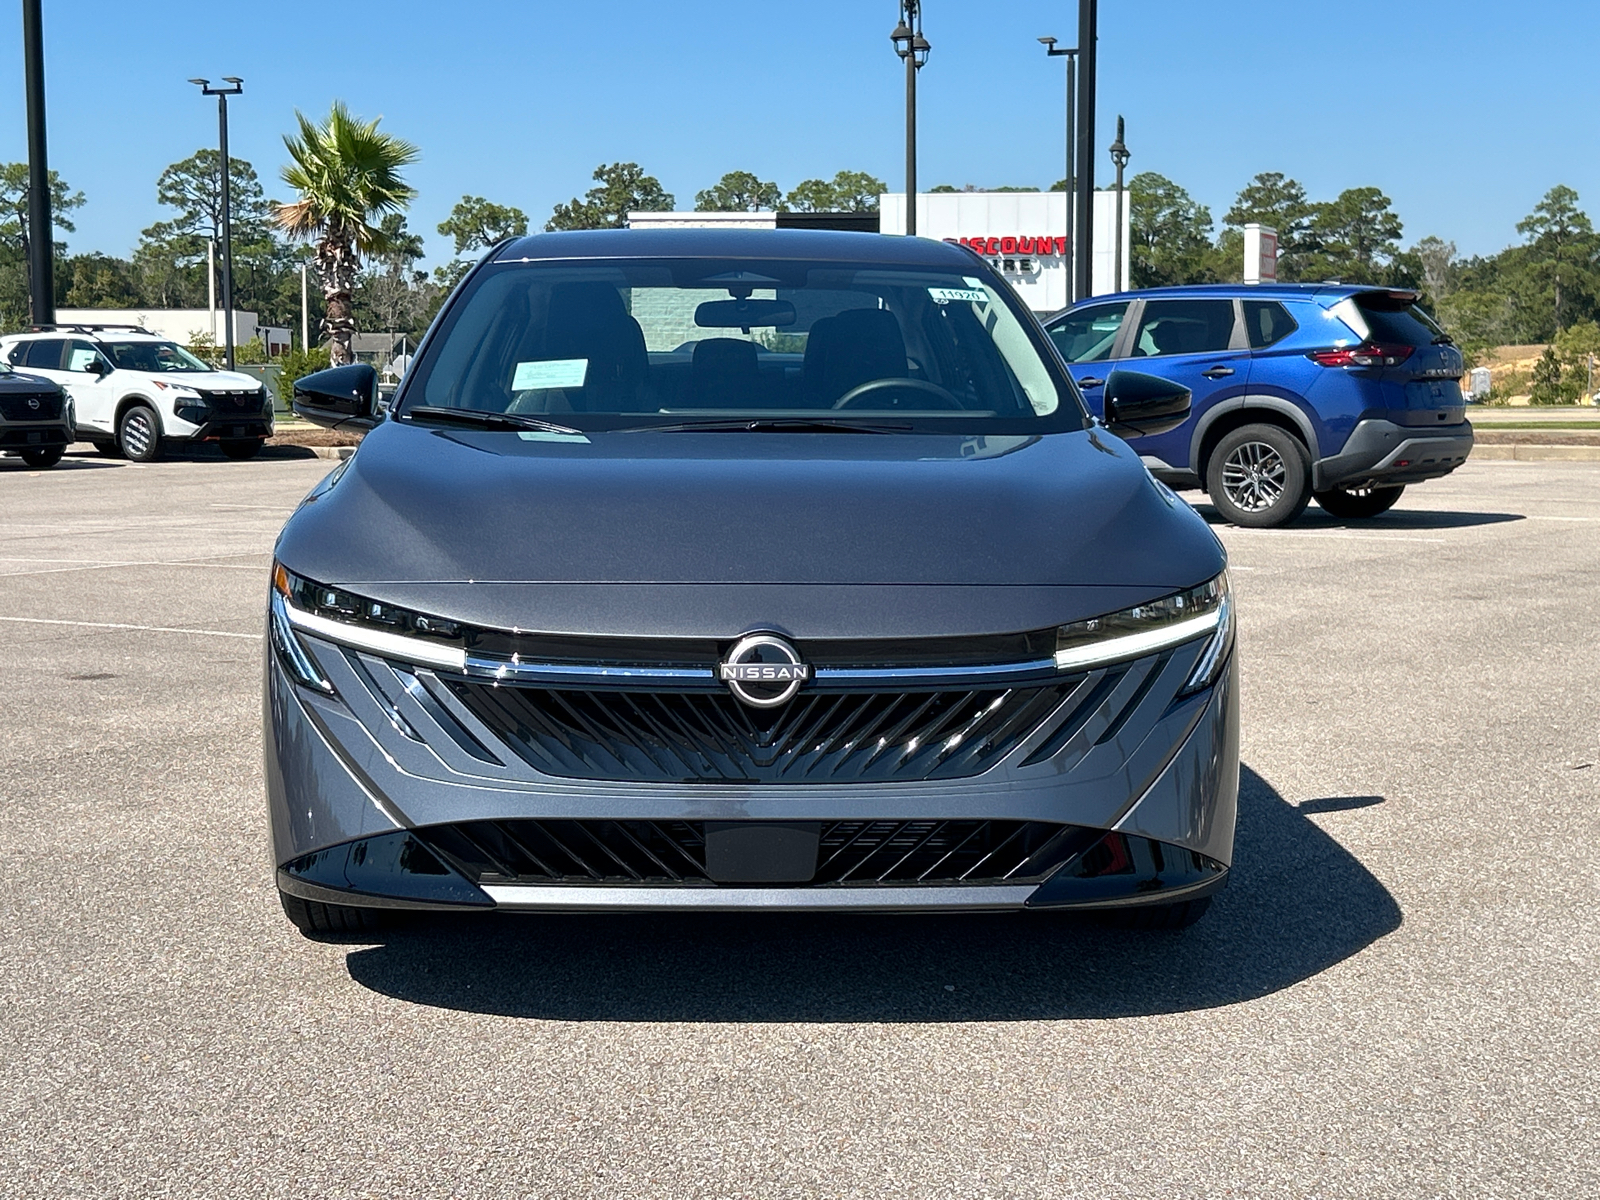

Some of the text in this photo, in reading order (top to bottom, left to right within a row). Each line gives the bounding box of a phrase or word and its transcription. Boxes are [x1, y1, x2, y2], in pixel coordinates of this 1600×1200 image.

[943, 235, 1067, 255] SCOUNT
[992, 259, 1031, 271] IRE
[723, 667, 807, 679] NISSAN
